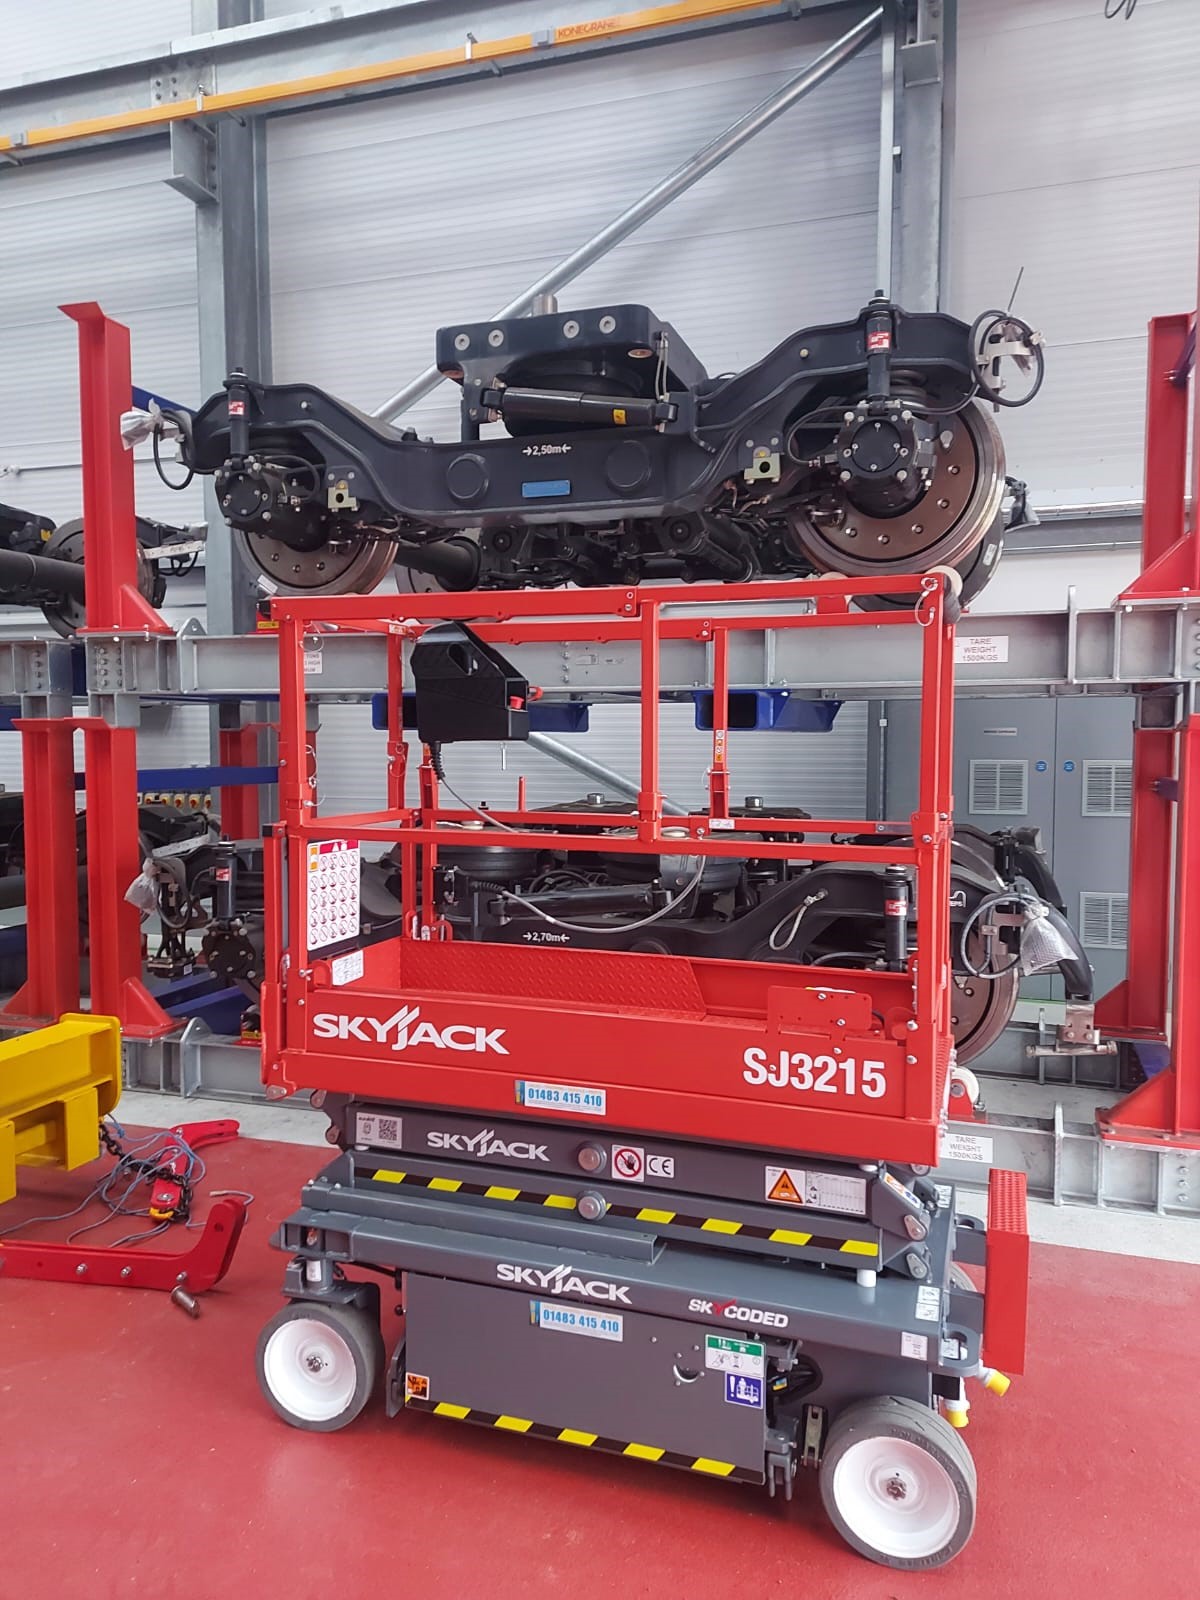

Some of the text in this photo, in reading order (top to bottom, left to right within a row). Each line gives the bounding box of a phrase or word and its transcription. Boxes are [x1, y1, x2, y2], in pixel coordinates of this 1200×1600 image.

[532, 444, 561, 456] 2,50m
[532, 932, 560, 942] 2,70m
[313, 1004, 510, 1055] SKYJACK
[743, 1047, 886, 1098] SJ3215
[528, 1087, 602, 1107] 01483 415 410
[426, 1128, 551, 1162] SKYJACK
[950, 1144, 982, 1152] WEIGHT
[955, 1136, 976, 1144] TARE
[496, 1263, 633, 1305] SKYJACK
[543, 1309, 619, 1332] 01483 415 410
